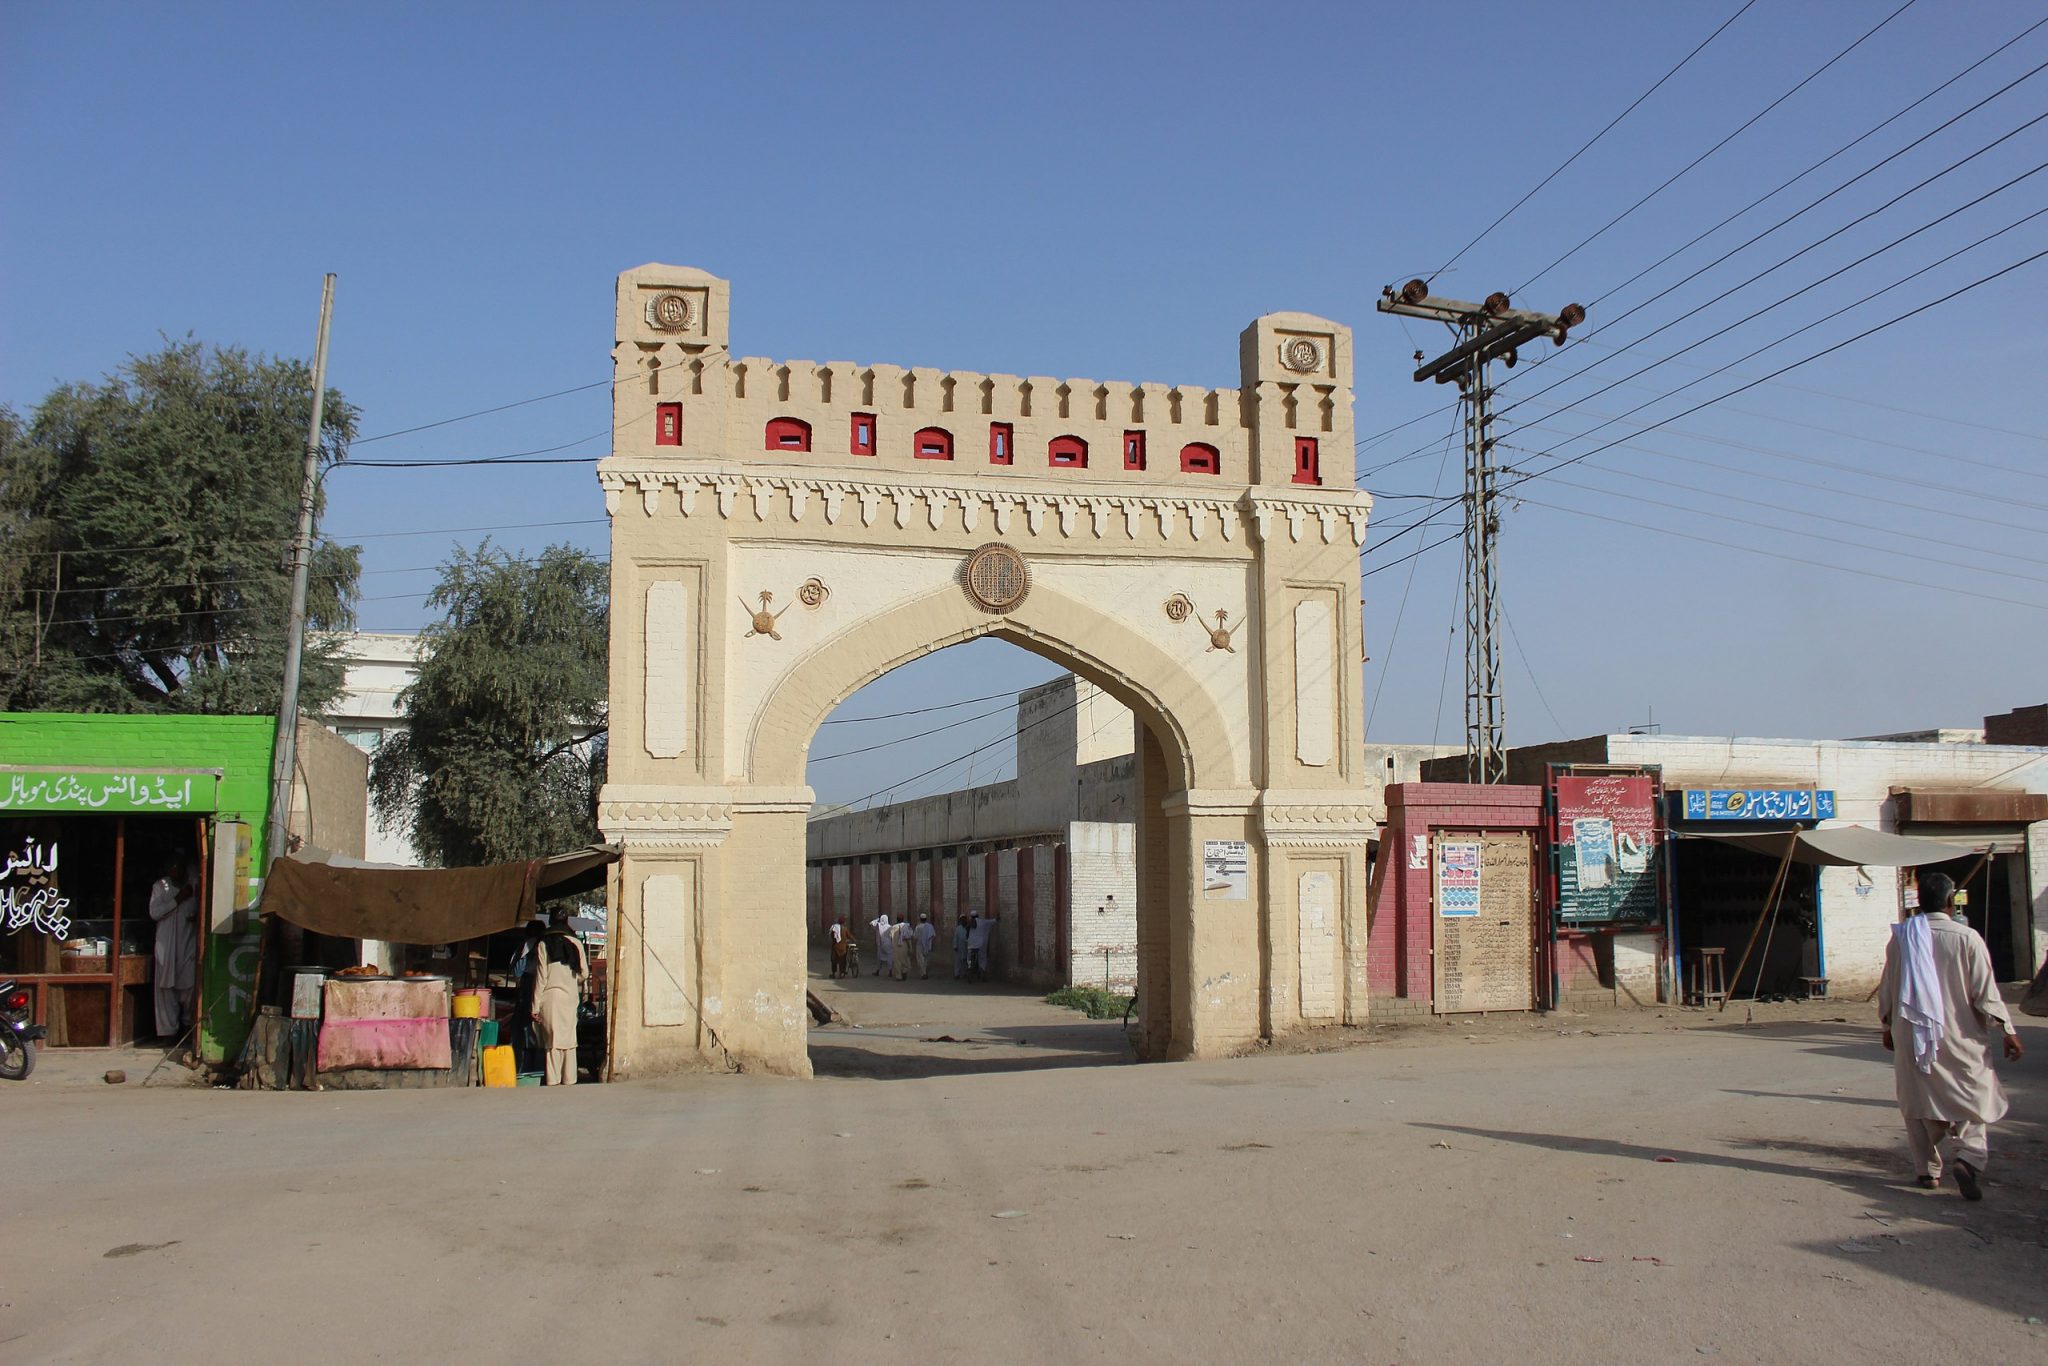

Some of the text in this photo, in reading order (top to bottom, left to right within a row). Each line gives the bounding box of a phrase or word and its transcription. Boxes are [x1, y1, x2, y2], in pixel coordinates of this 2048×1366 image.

[45, 775, 88, 806] پنڈی
[87, 775, 192, 809] ایڈوانس
[1774, 791, 1811, 819] رضوان
